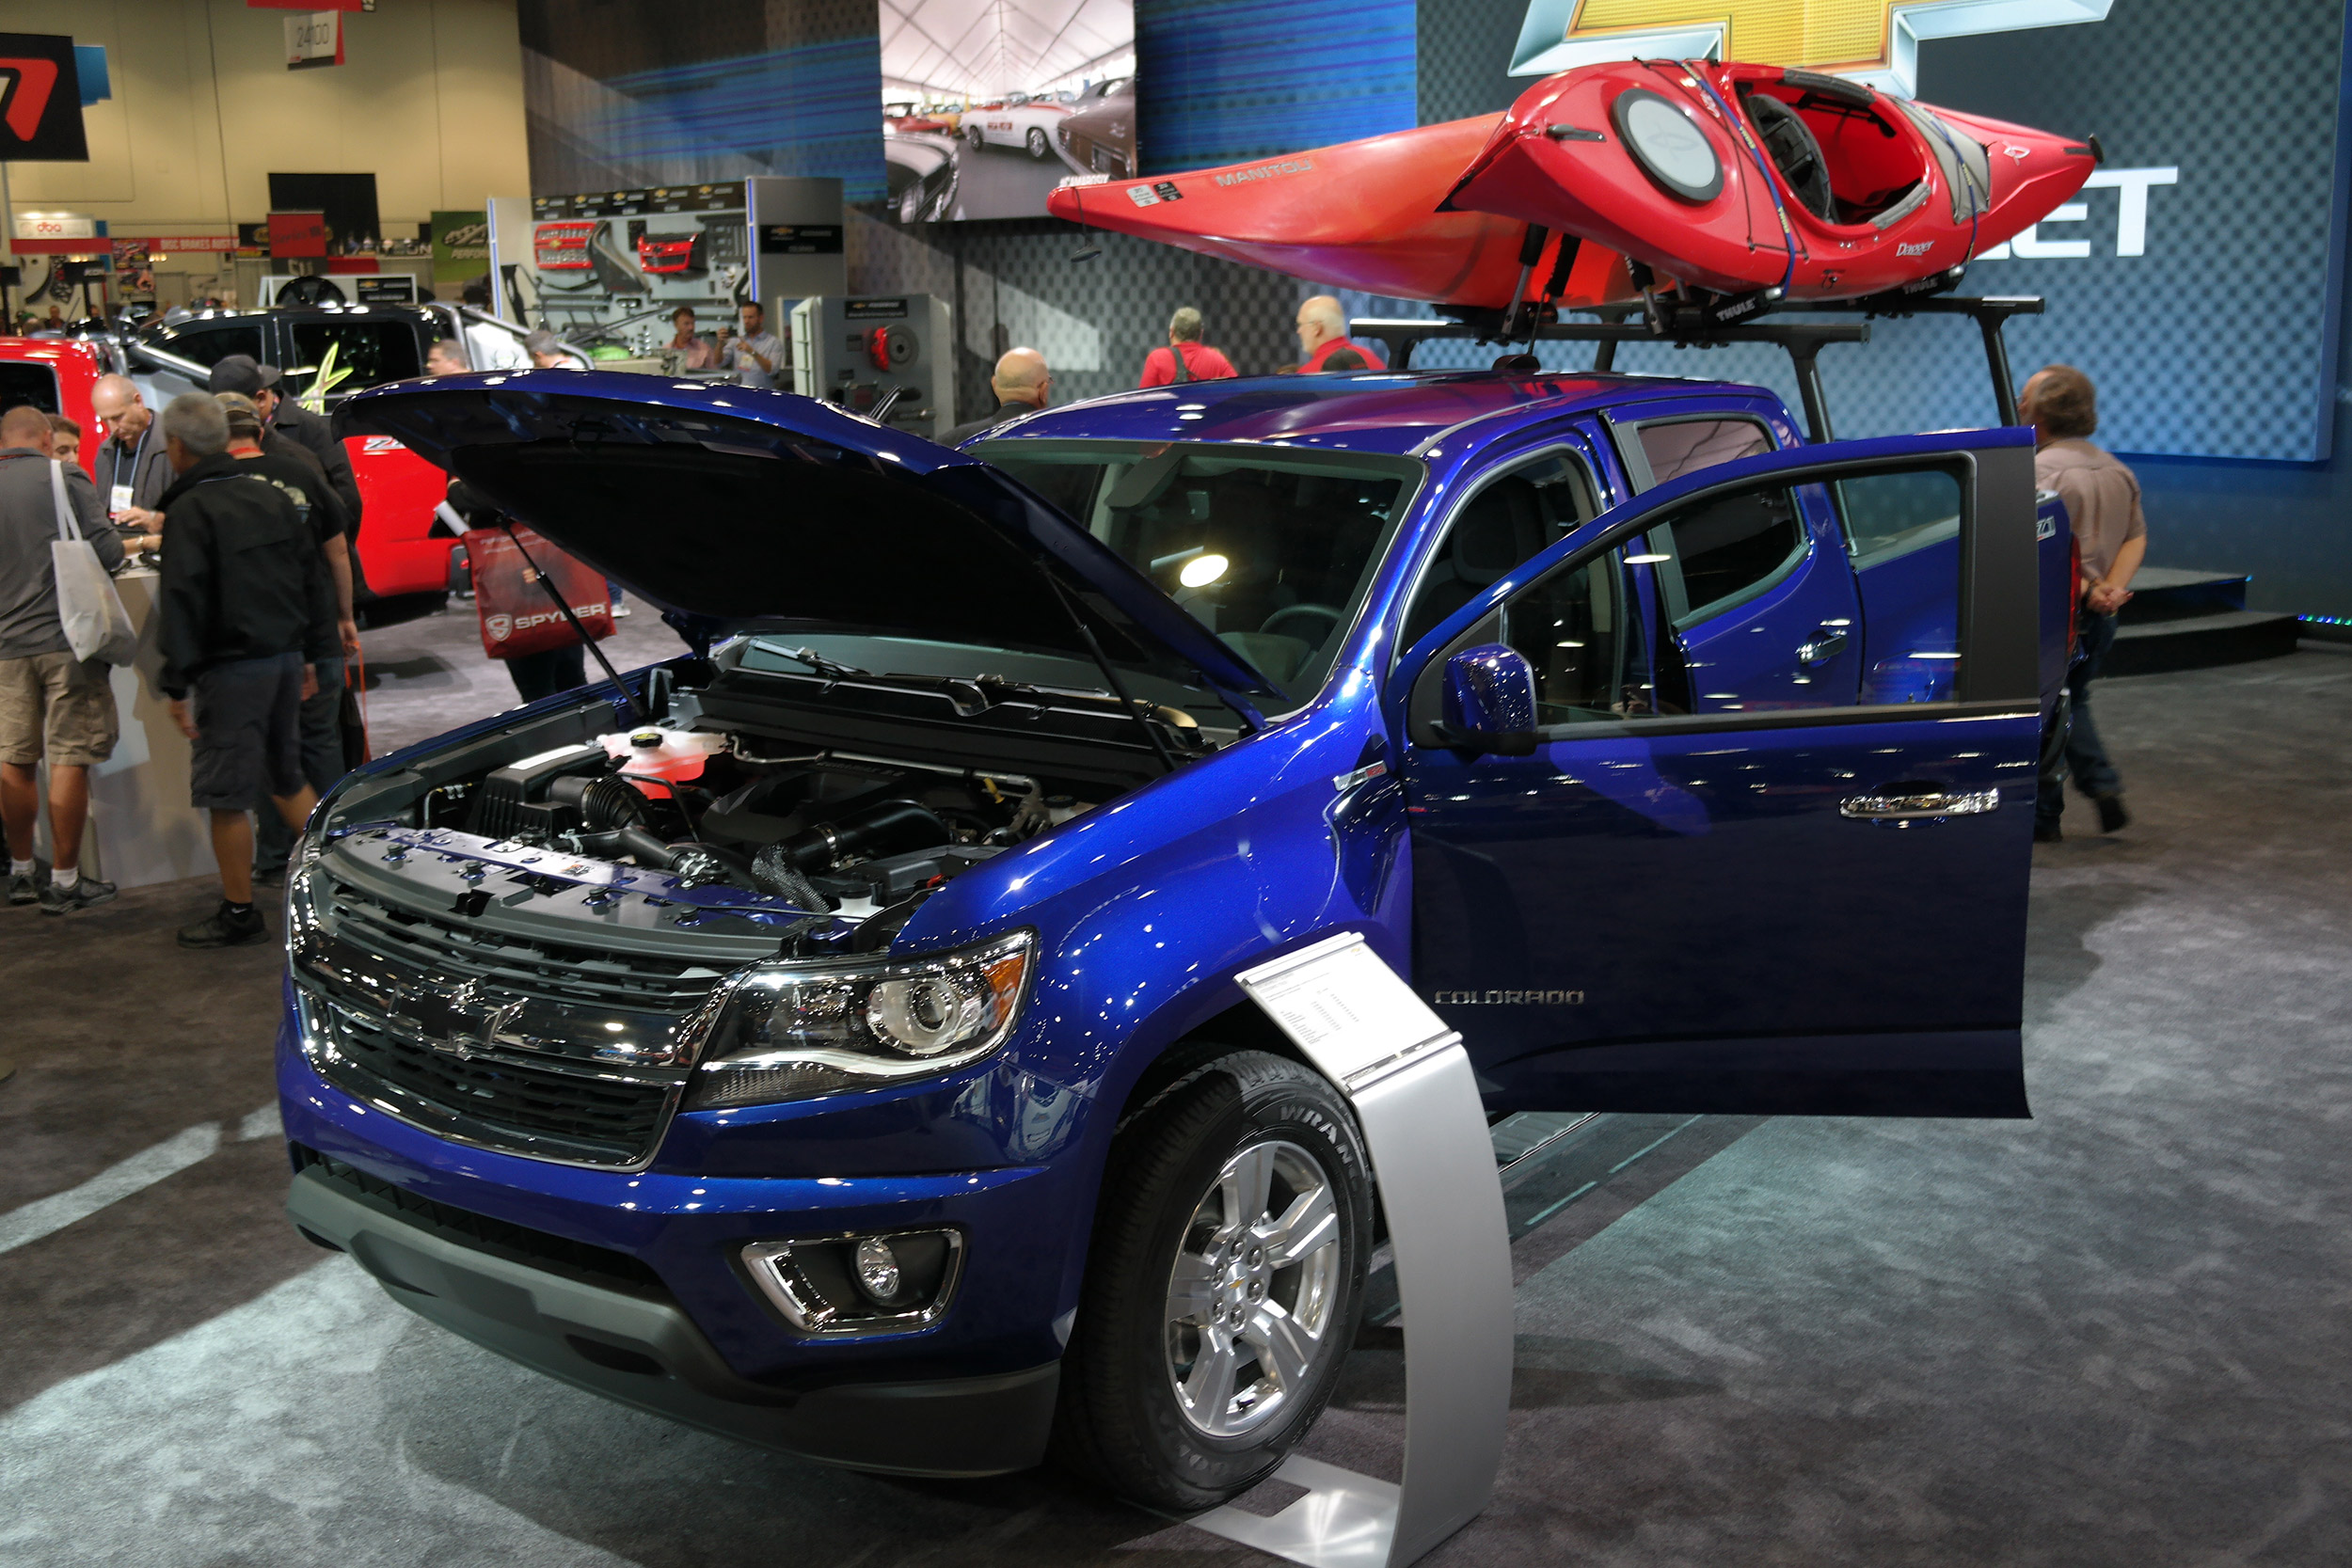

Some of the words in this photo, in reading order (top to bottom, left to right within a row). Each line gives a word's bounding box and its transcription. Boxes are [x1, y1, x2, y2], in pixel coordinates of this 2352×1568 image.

[1215, 158, 1313, 187] MANITOU
[1973, 166, 2179, 261] ET
[160, 238, 179, 250] DISC
[180, 238, 211, 250] BRAKES
[1715, 297, 1756, 322] THULE
[1434, 990, 1585, 1006] COLORADO
